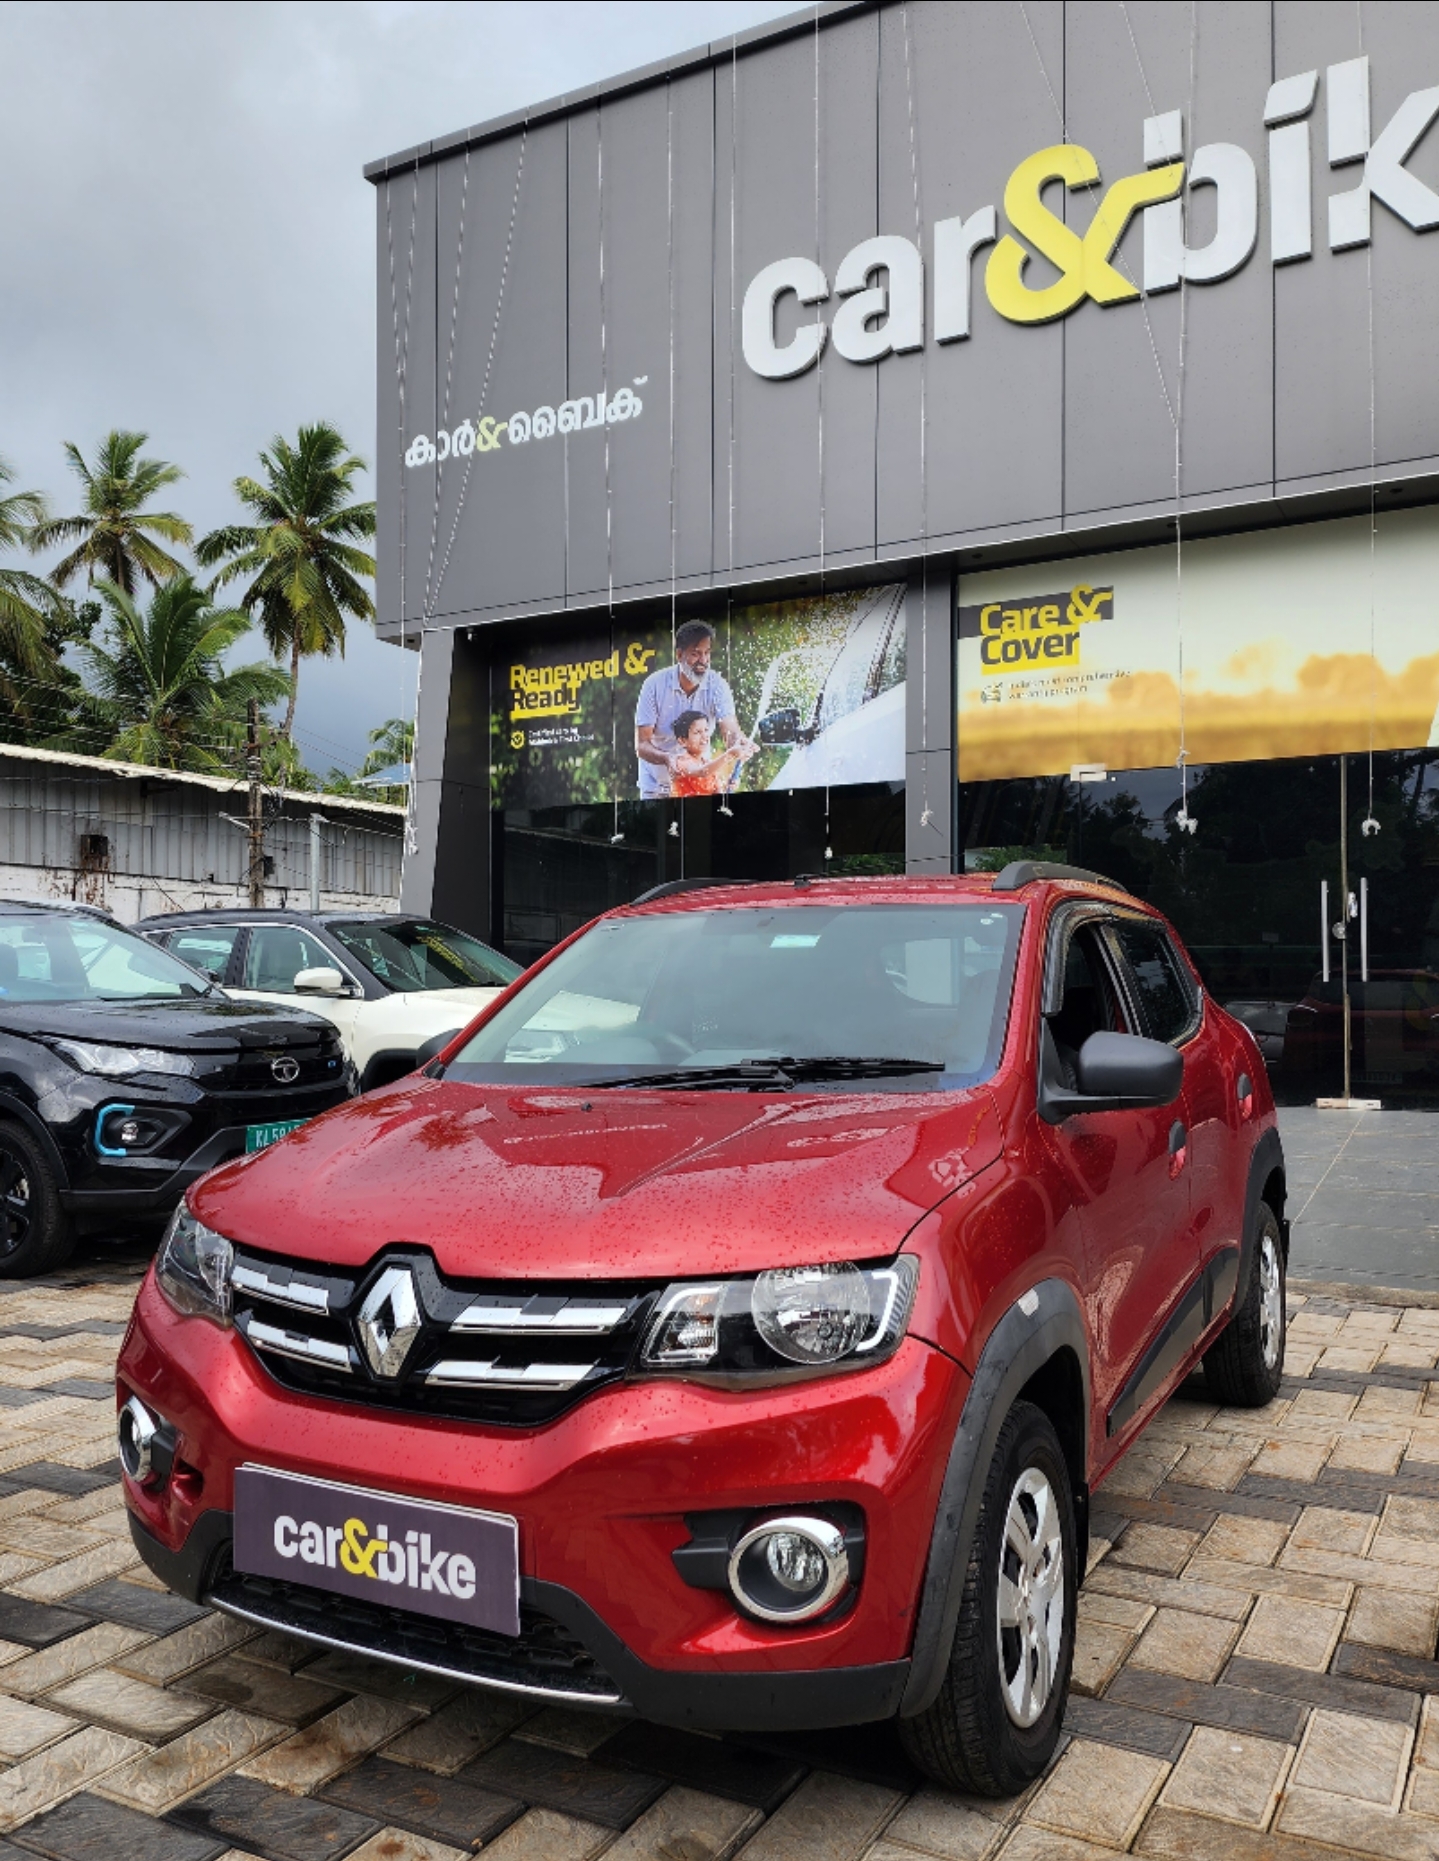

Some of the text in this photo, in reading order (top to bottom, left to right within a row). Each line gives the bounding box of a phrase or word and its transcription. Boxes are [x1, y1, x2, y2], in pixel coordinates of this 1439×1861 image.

[980, 583, 1113, 636] Care &
[510, 642, 655, 690] Renewed &
[981, 631, 1080, 665] Cover
[512, 686, 581, 711] Ready
[274, 1515, 476, 1599] car&bike
